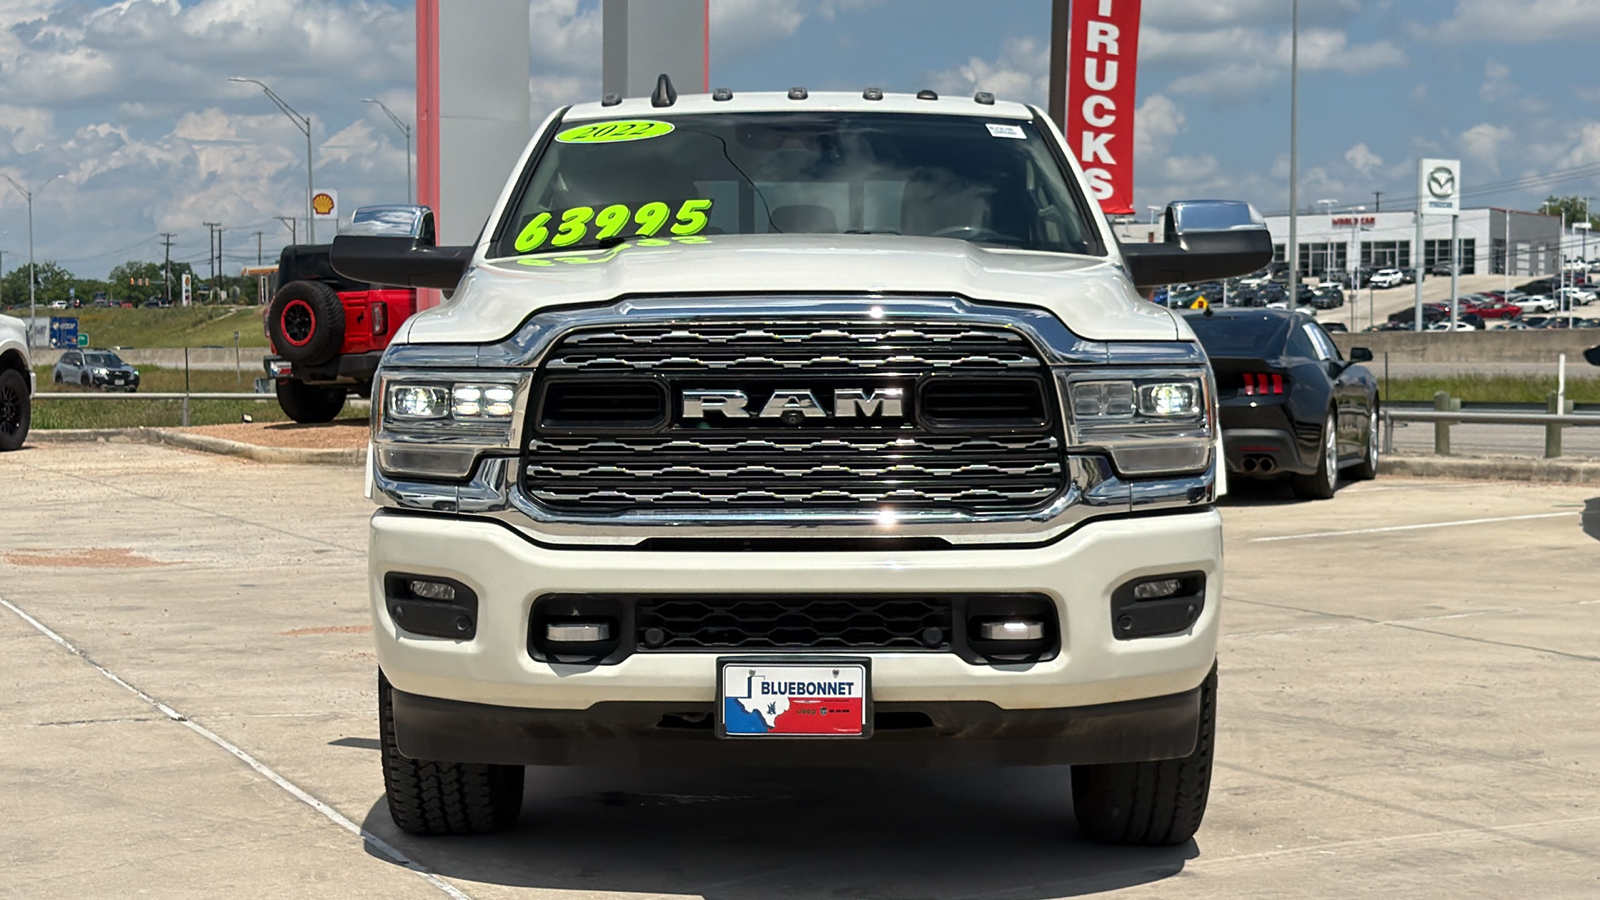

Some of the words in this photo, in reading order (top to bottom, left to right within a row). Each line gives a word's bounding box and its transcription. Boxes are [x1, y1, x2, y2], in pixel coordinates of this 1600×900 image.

[571, 123, 656, 140] 2022
[514, 199, 712, 252] 63995
[682, 389, 903, 418] RAM
[761, 681, 854, 696] BLUEBONNET
